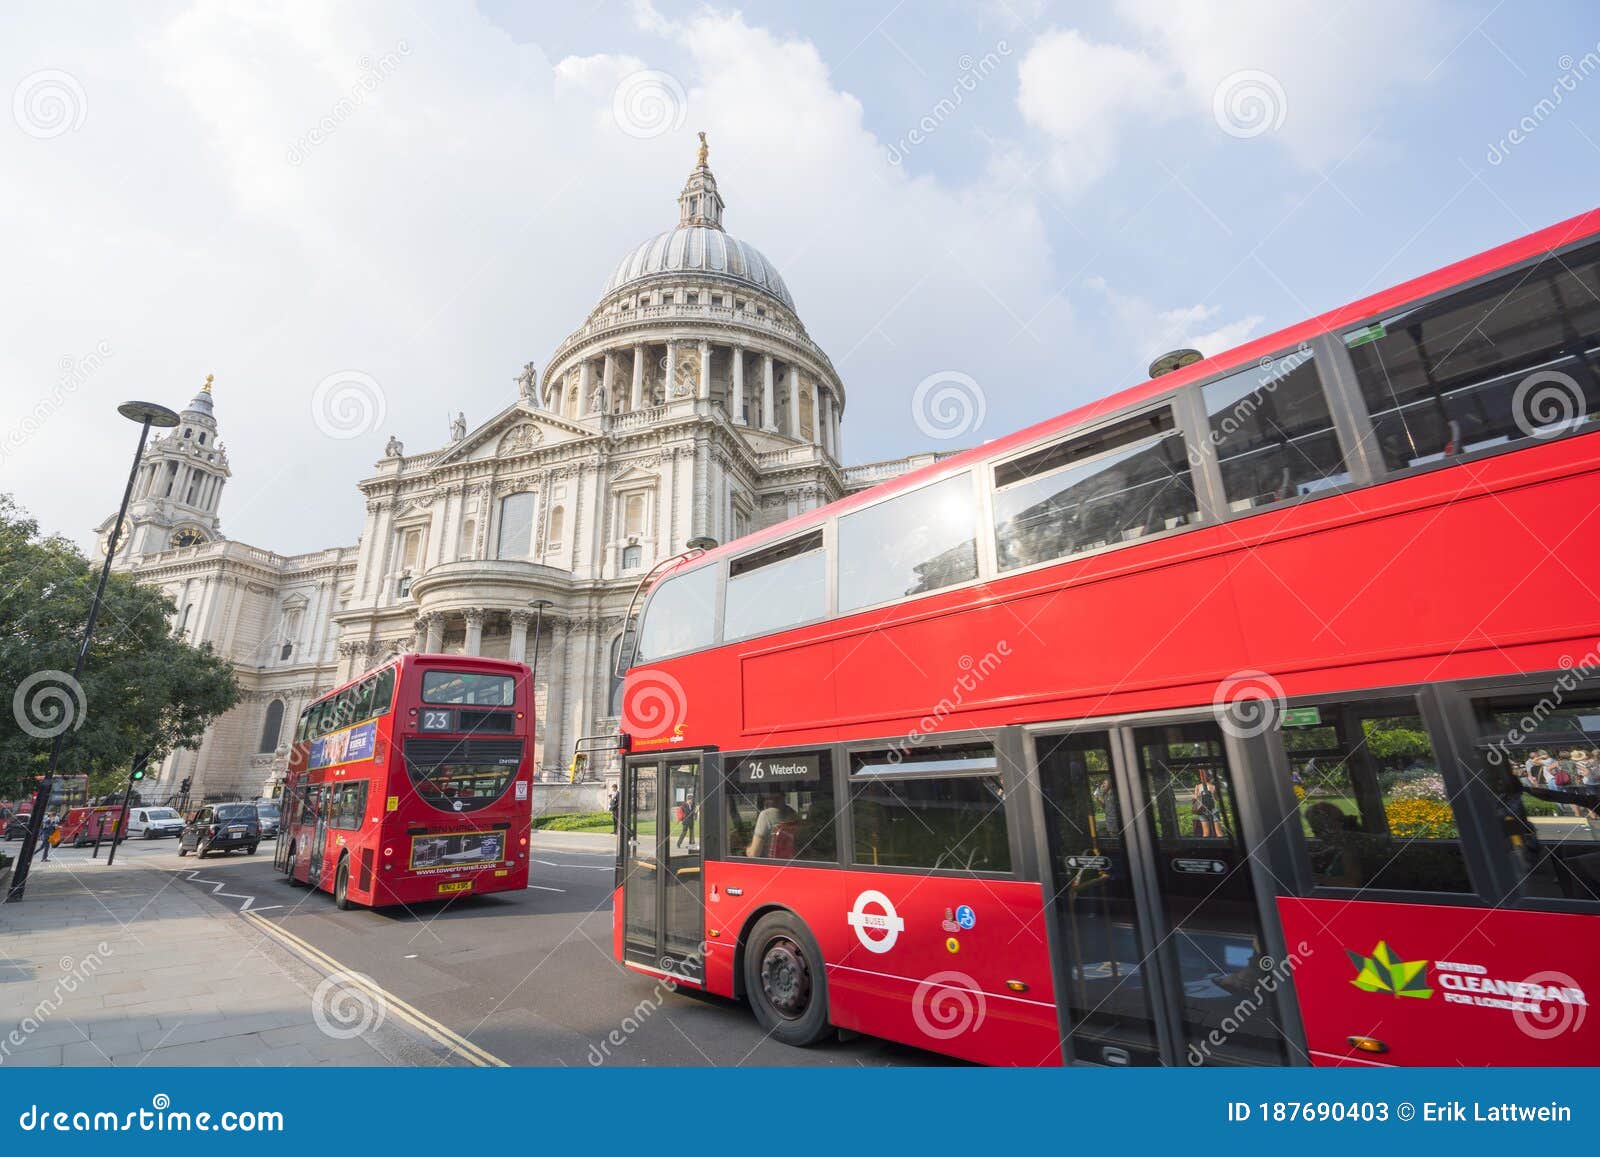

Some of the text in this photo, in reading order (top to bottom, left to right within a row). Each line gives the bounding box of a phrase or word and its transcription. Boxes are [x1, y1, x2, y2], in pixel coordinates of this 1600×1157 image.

[424, 712, 447, 729] 23
[749, 762, 808, 779] 26 Waterloo
[864, 916, 887, 927] BUSES
